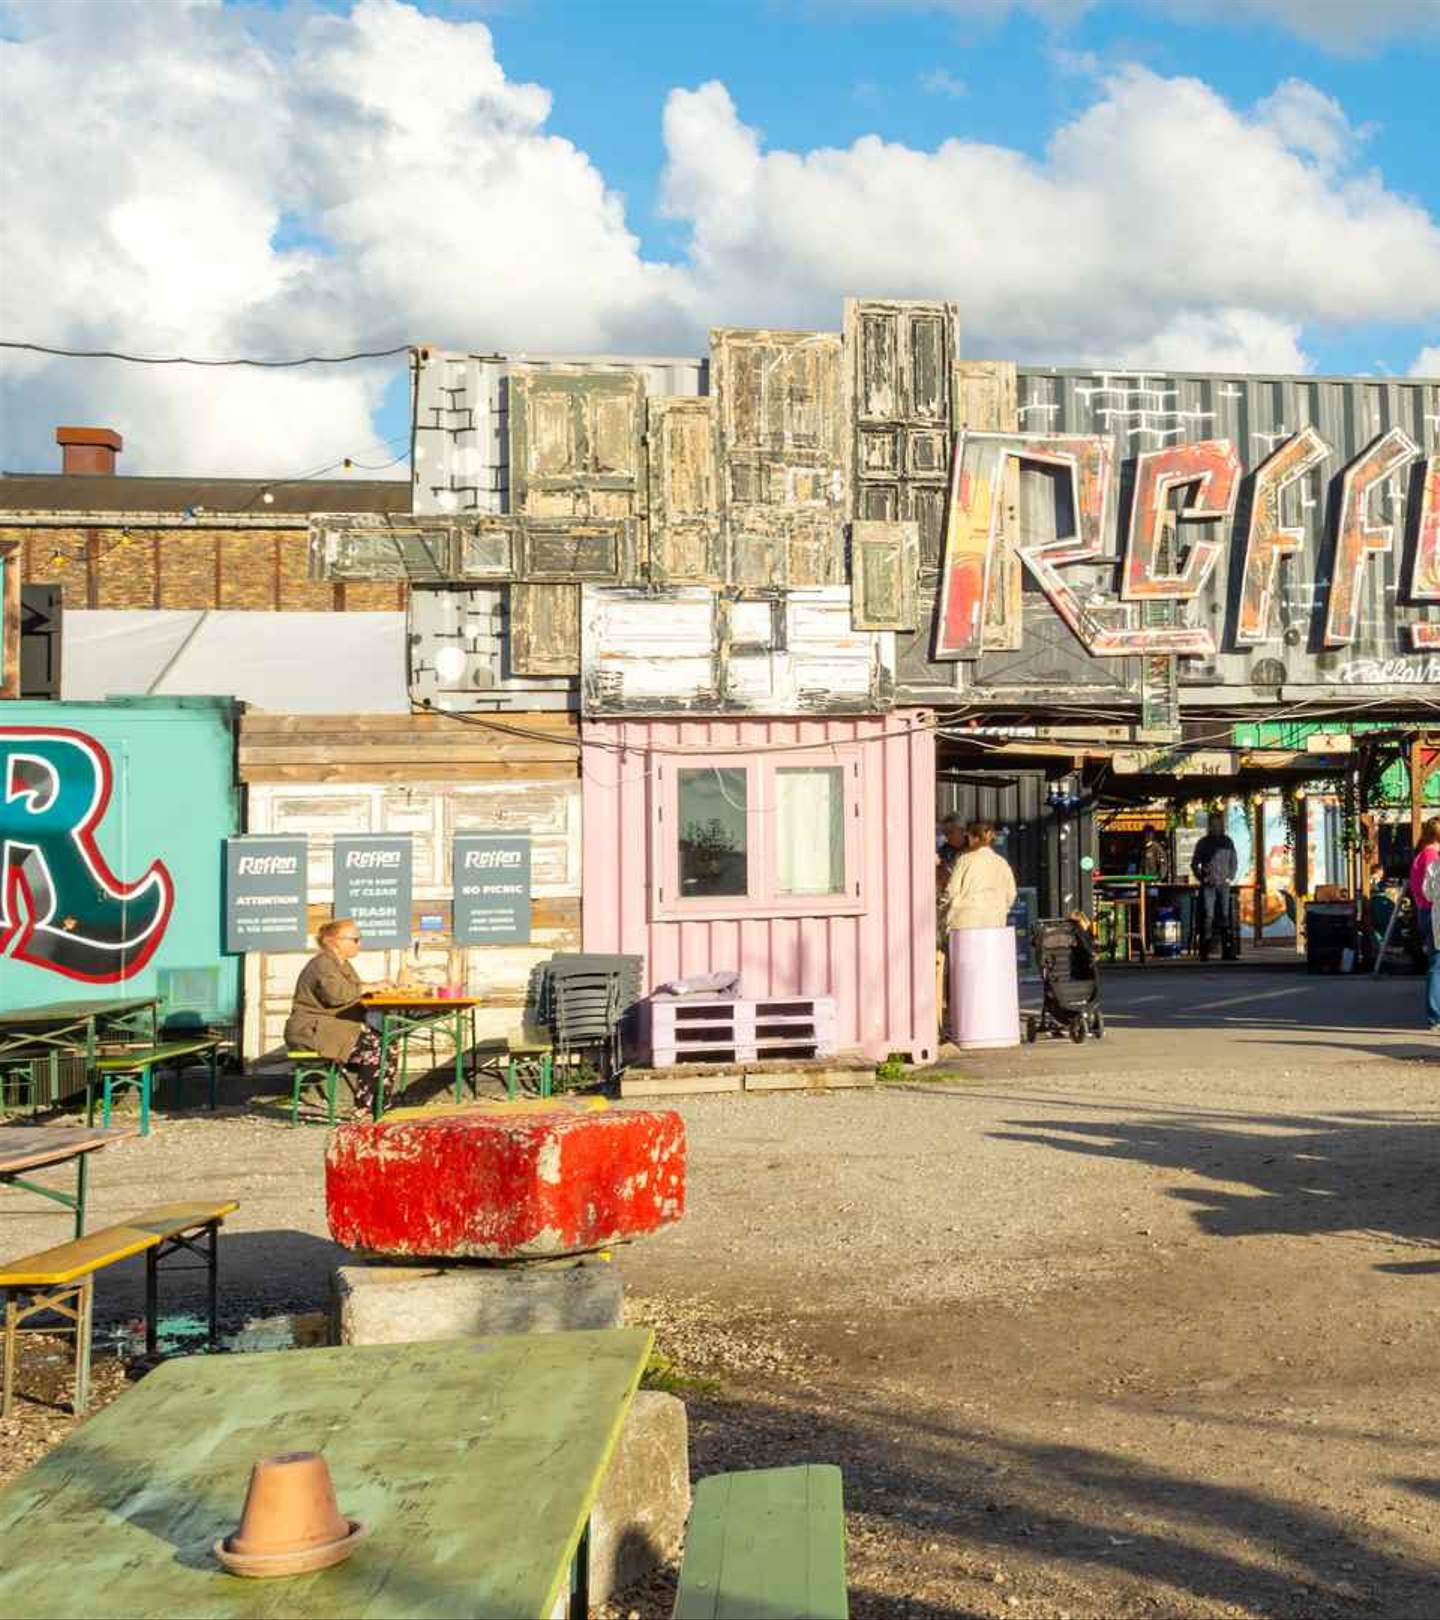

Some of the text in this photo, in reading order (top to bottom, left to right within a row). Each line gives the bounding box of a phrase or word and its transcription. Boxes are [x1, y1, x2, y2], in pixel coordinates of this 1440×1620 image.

[238, 856, 297, 875] Reffen
[346, 851, 400, 868] Reffen
[465, 851, 521, 868] Reffen
[483, 885, 523, 895] PICNIC
[350, 907, 397, 918] TRASH
